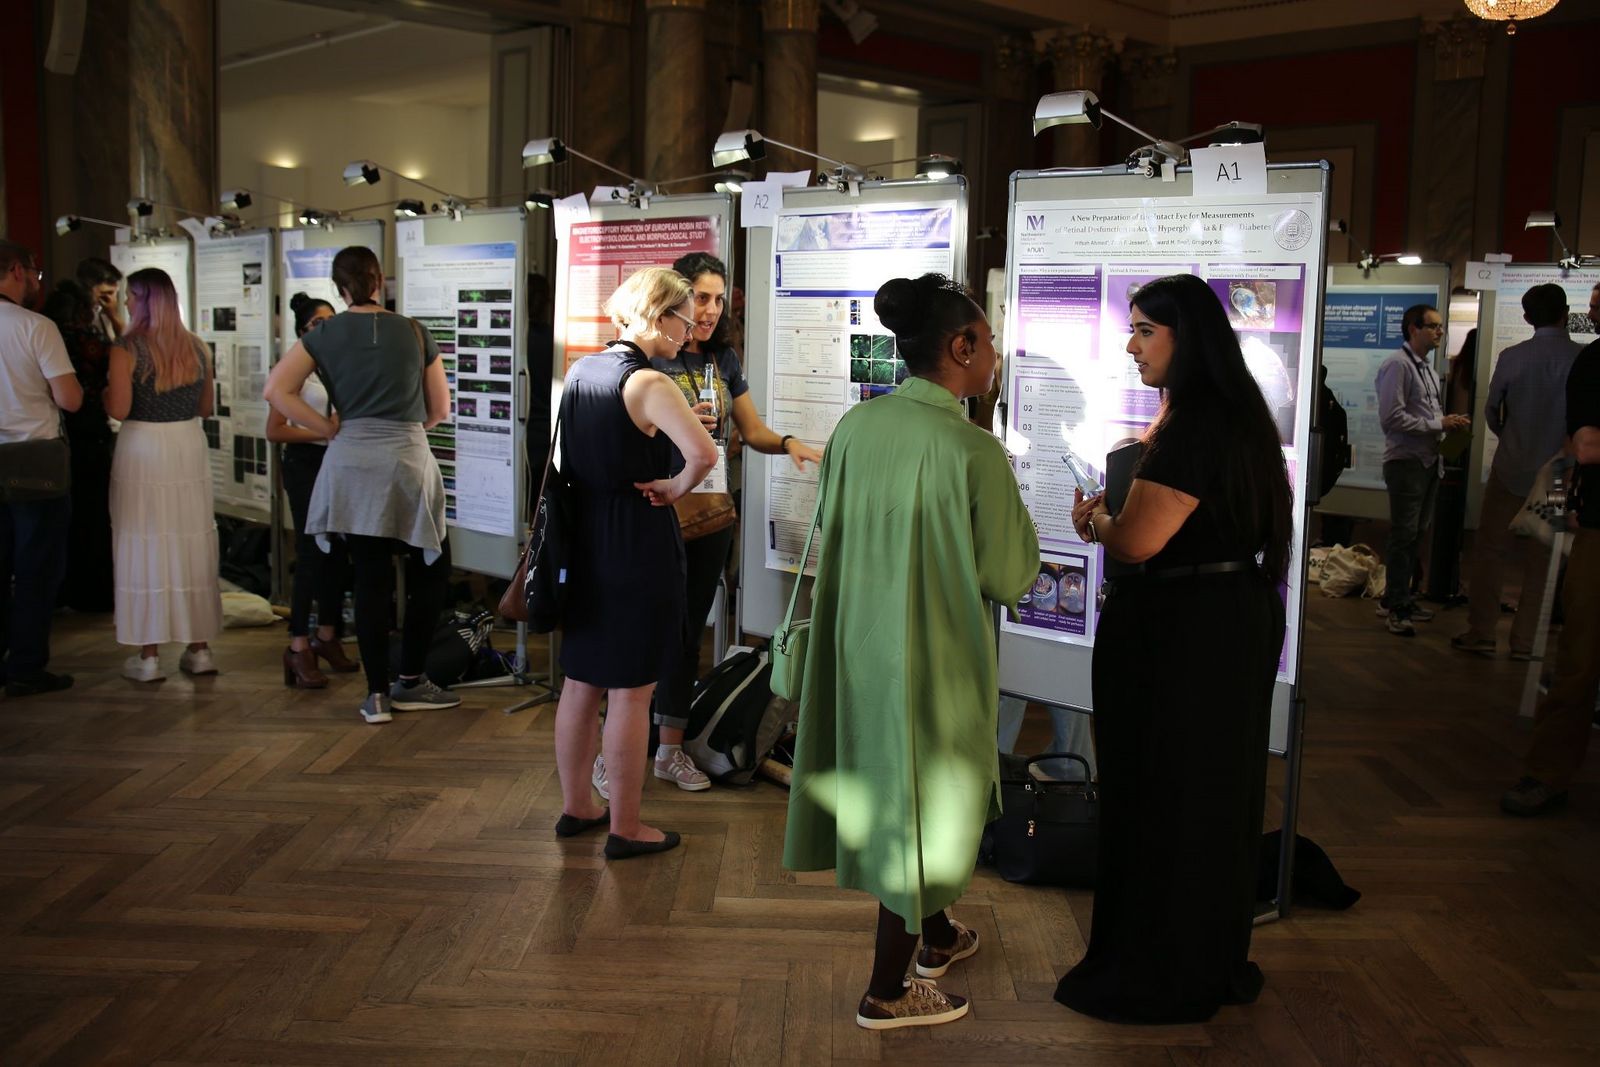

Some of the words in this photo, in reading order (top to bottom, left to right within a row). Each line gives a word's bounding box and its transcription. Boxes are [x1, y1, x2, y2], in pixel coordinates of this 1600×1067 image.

[1216, 162, 1242, 181] A1
[754, 194, 768, 209] A2
[1092, 213, 1131, 223] Preparation
[1176, 212, 1188, 220] Eye
[1188, 211, 1198, 220] for
[1200, 210, 1254, 220] Measurements
[620, 224, 644, 234] FUNCTION
[644, 224, 652, 232] OF
[652, 222, 678, 232] EUROPEAN
[678, 222, 694, 231] ROBIN
[696, 220, 712, 230] RETIN
[1158, 224, 1210, 233] Hyperglyia
[1239, 223, 1272, 232] Diabetes
[636, 233, 646, 242] AND
[646, 231, 689, 242] MORPHOLOGICAL
[689, 230, 706, 240] STUDY
[1478, 270, 1492, 280] C2
